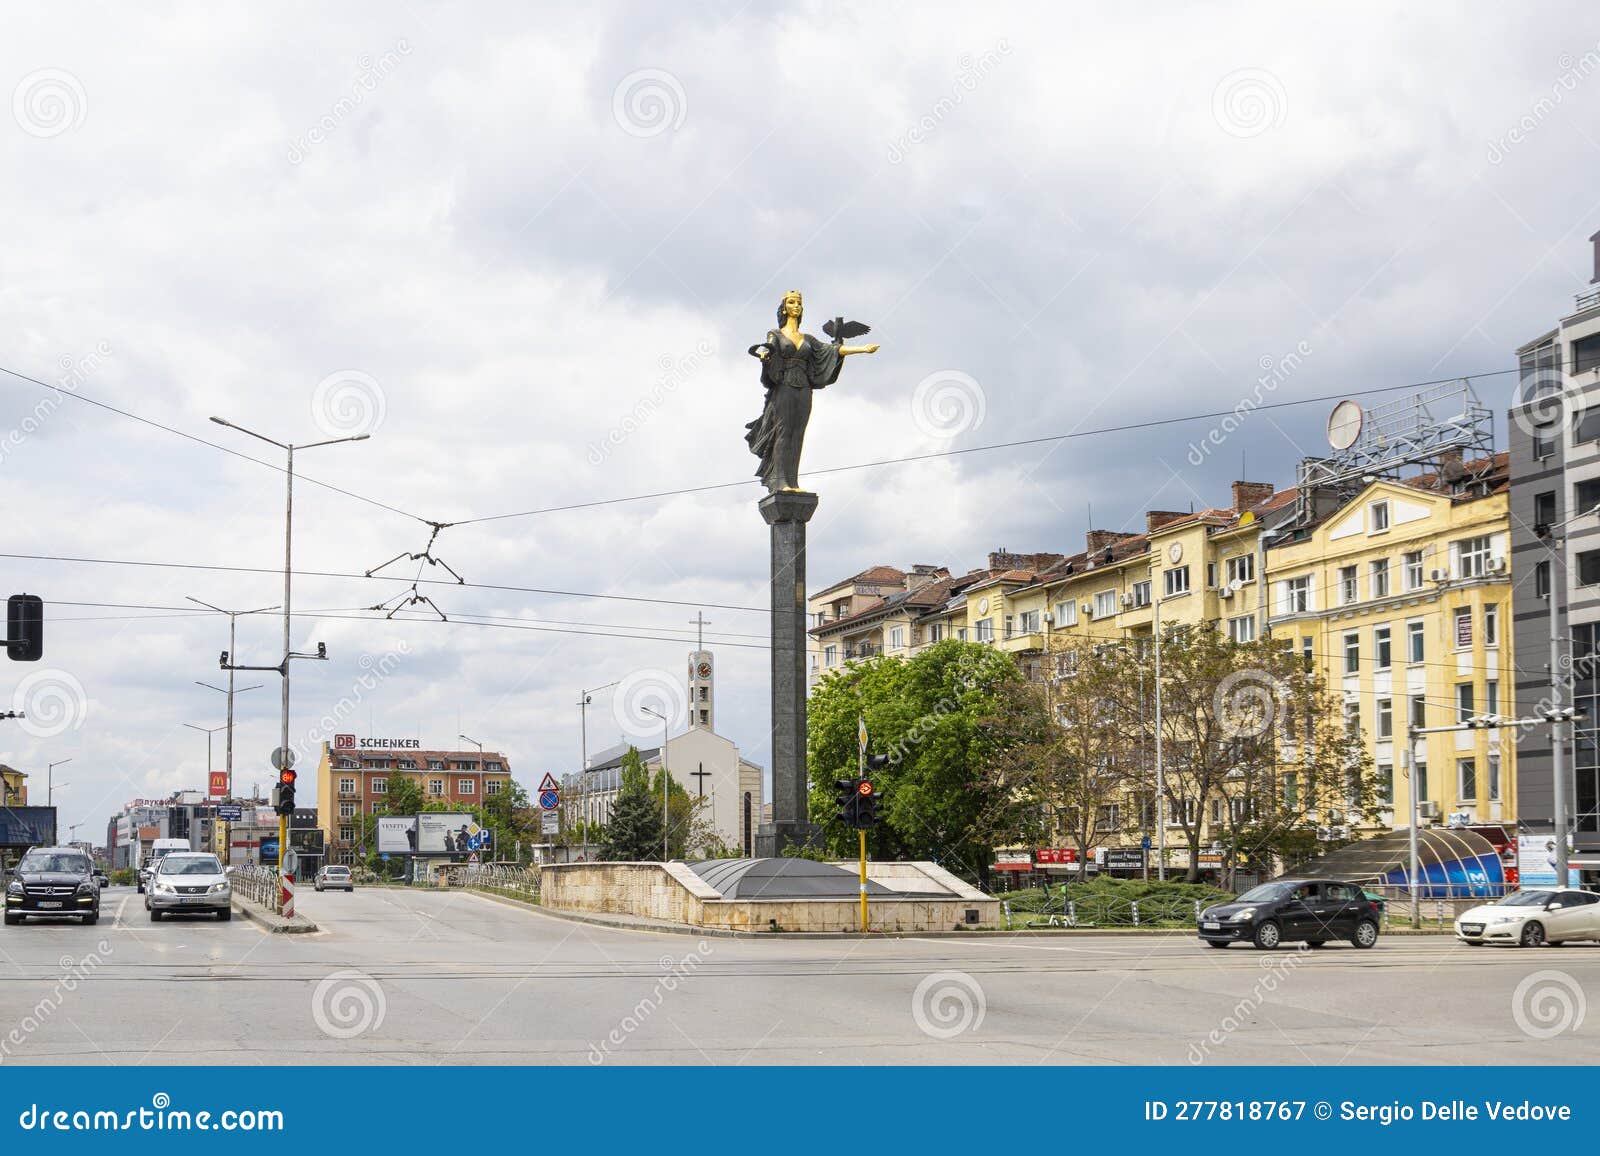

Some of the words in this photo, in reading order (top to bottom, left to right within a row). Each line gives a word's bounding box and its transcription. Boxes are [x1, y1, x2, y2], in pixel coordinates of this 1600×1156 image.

[337, 736, 353, 747] DB
[360, 738, 420, 748] SCHENKER
[481, 829, 489, 842] P
